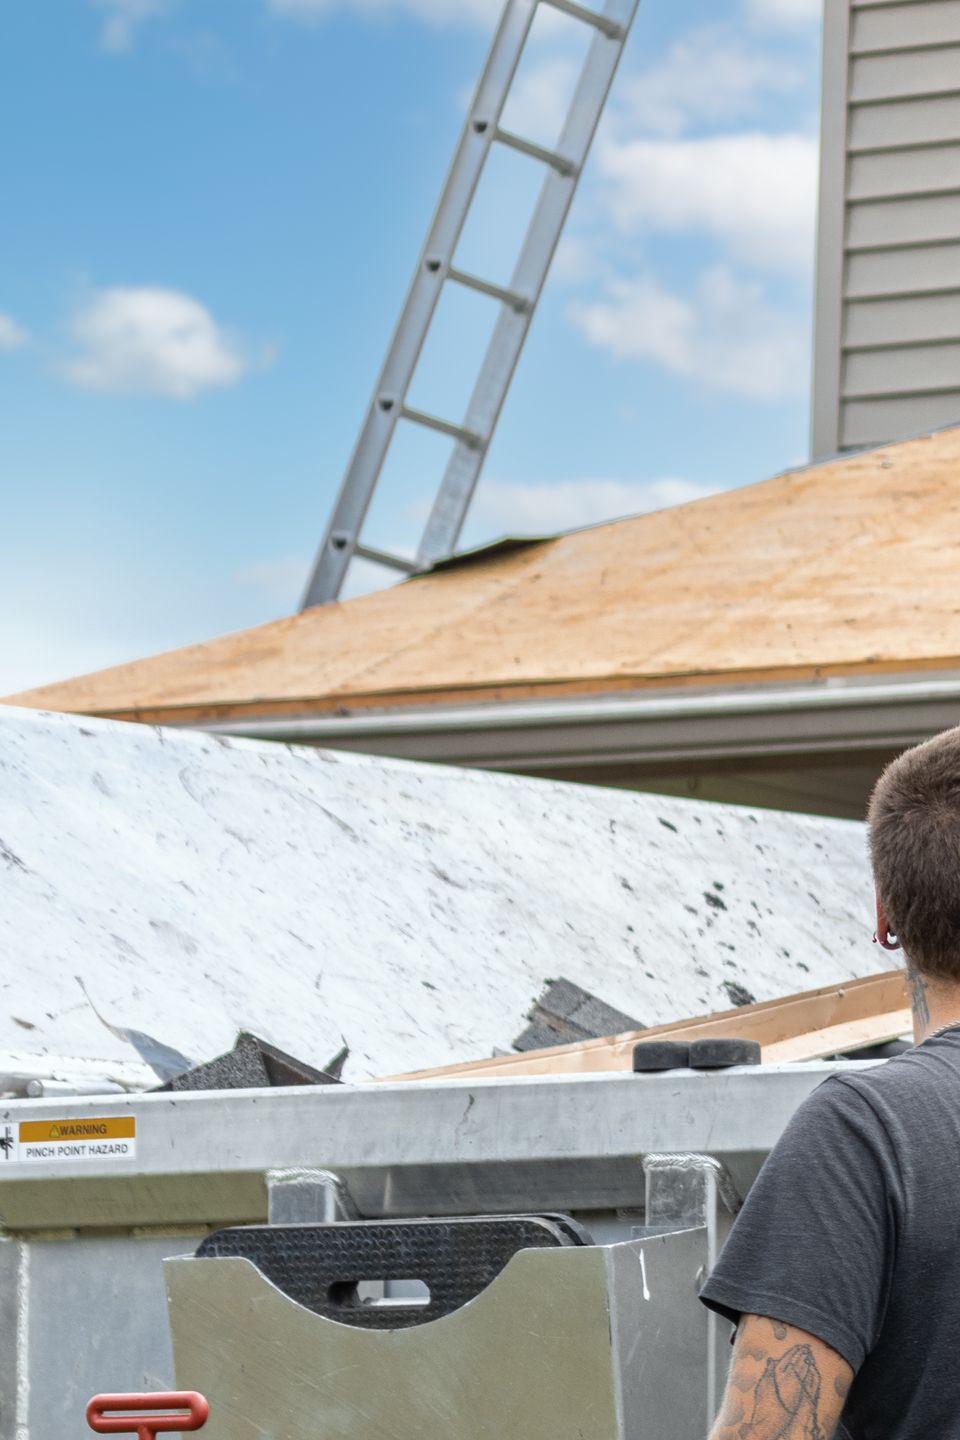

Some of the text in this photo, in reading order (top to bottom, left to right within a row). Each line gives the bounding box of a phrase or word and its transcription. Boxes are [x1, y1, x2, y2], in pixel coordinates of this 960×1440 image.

[60, 1124, 107, 1135] WARNING
[26, 1144, 128, 1157] PINCH POINT HAZARD
